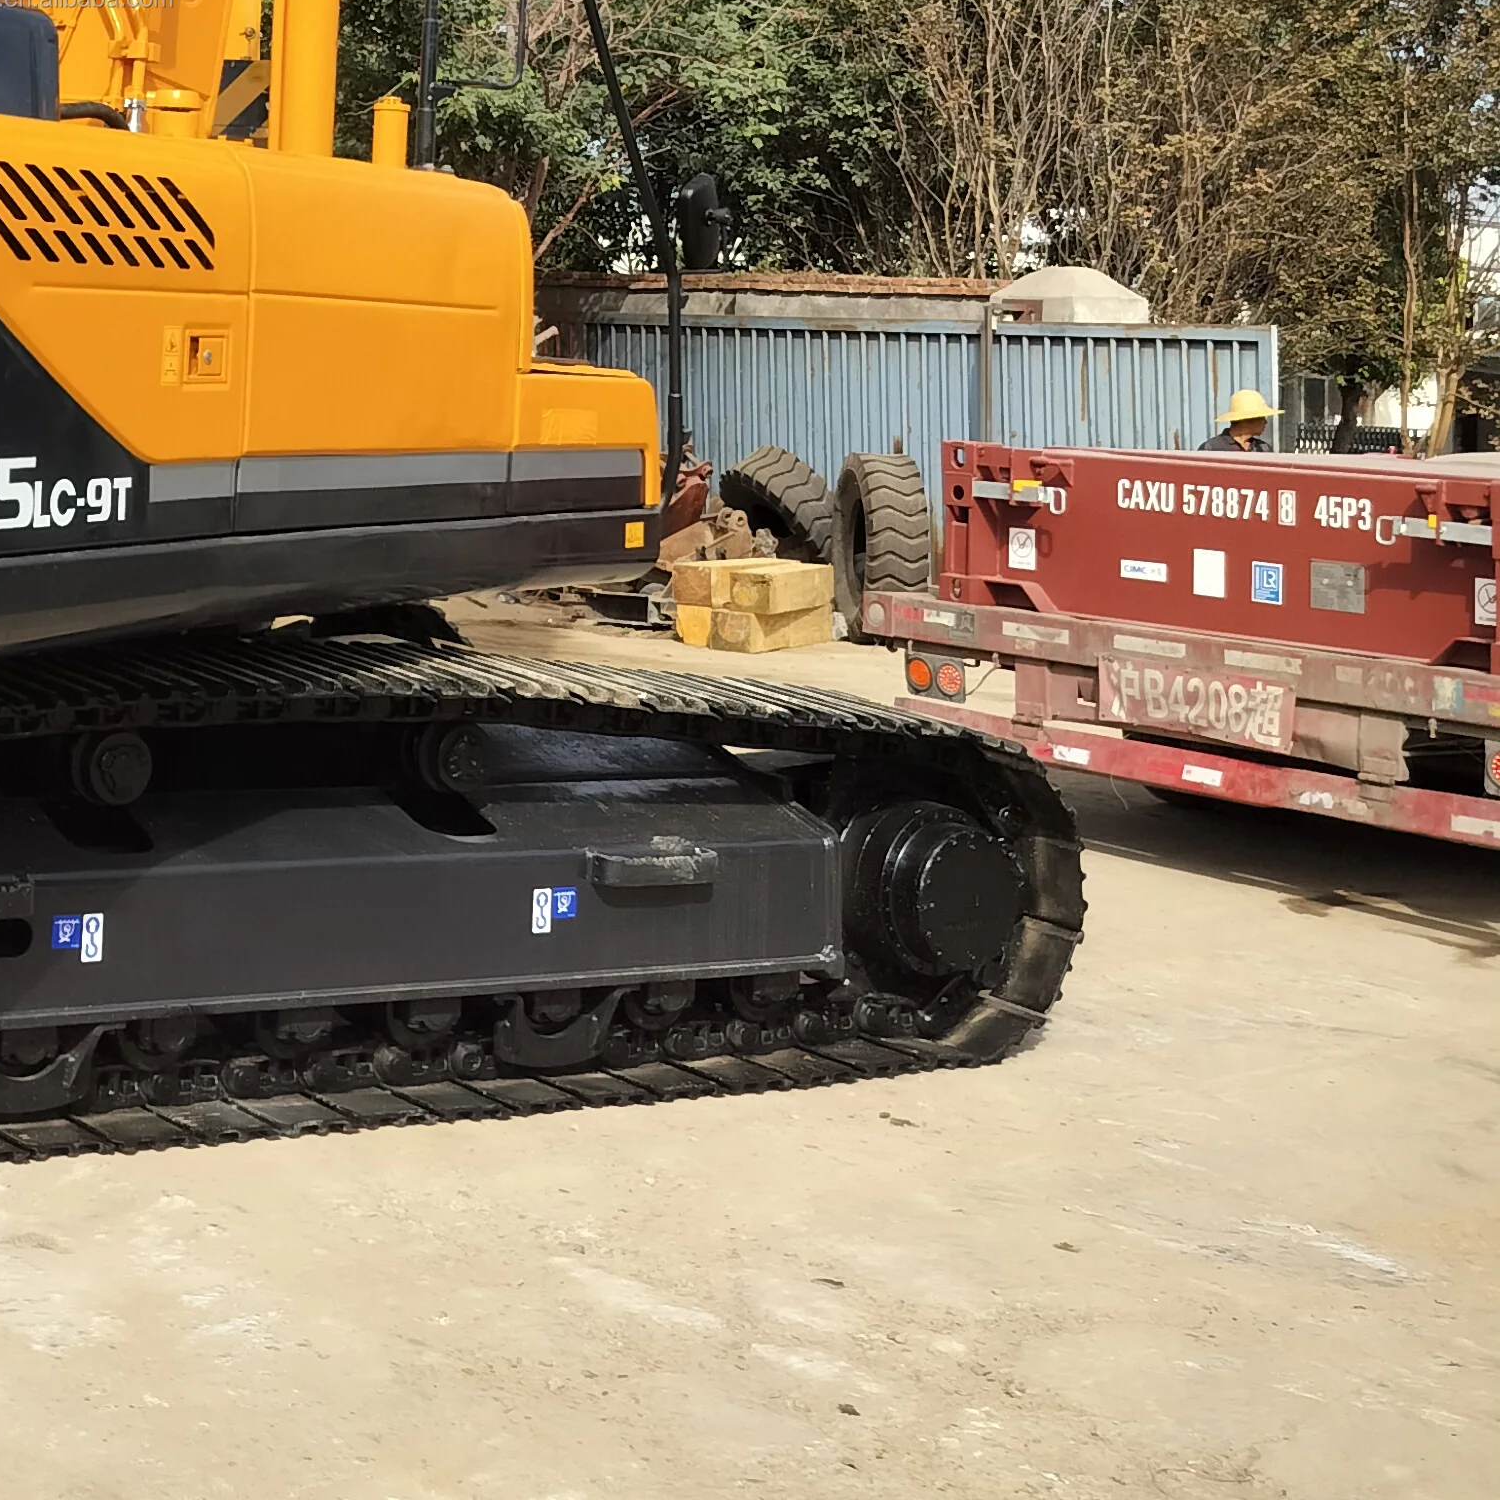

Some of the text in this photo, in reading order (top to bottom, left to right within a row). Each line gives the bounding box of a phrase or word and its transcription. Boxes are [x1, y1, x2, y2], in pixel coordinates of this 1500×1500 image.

[1117, 479, 1373, 531] CAXU 578874 8 45P3
[1110, 660, 1284, 747] 沪B4208超
